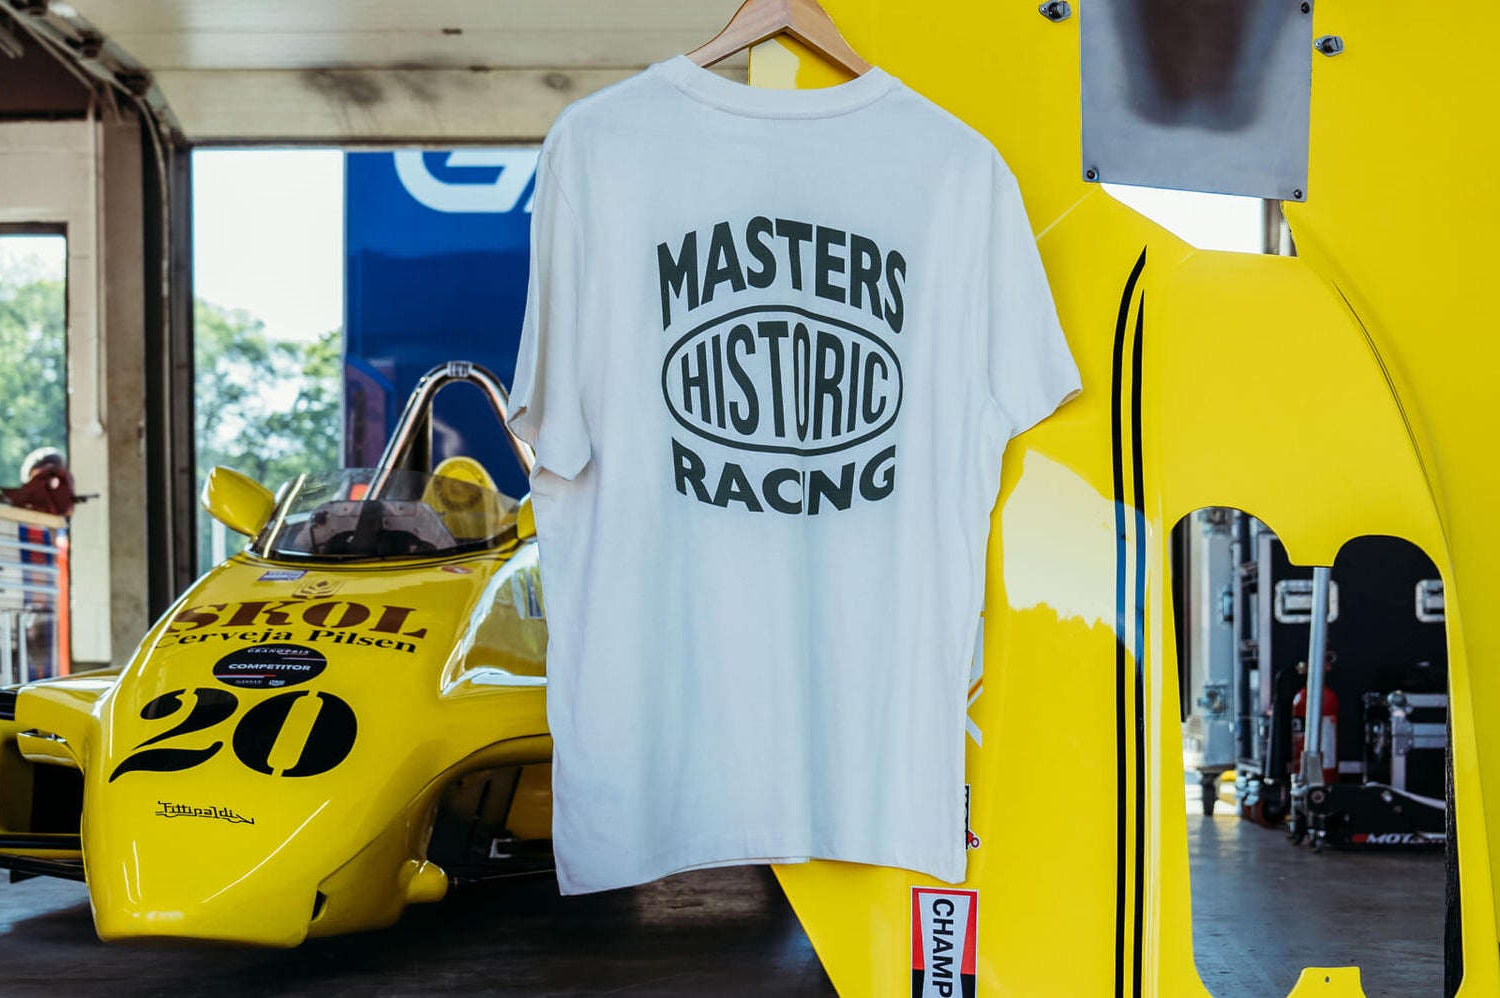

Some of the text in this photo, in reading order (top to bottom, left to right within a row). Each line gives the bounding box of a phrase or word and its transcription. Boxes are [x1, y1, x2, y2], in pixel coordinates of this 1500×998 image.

[657, 215, 907, 334] MASTERS
[681, 320, 888, 443] HISTORIC
[671, 436, 896, 516] RACNG
[155, 628, 416, 653] Cerveja Pilsen
[166, 600, 427, 639] SKOL
[228, 663, 311, 671] COMPETITOR
[109, 688, 358, 783] 20
[932, 898, 954, 998] CHAMP
